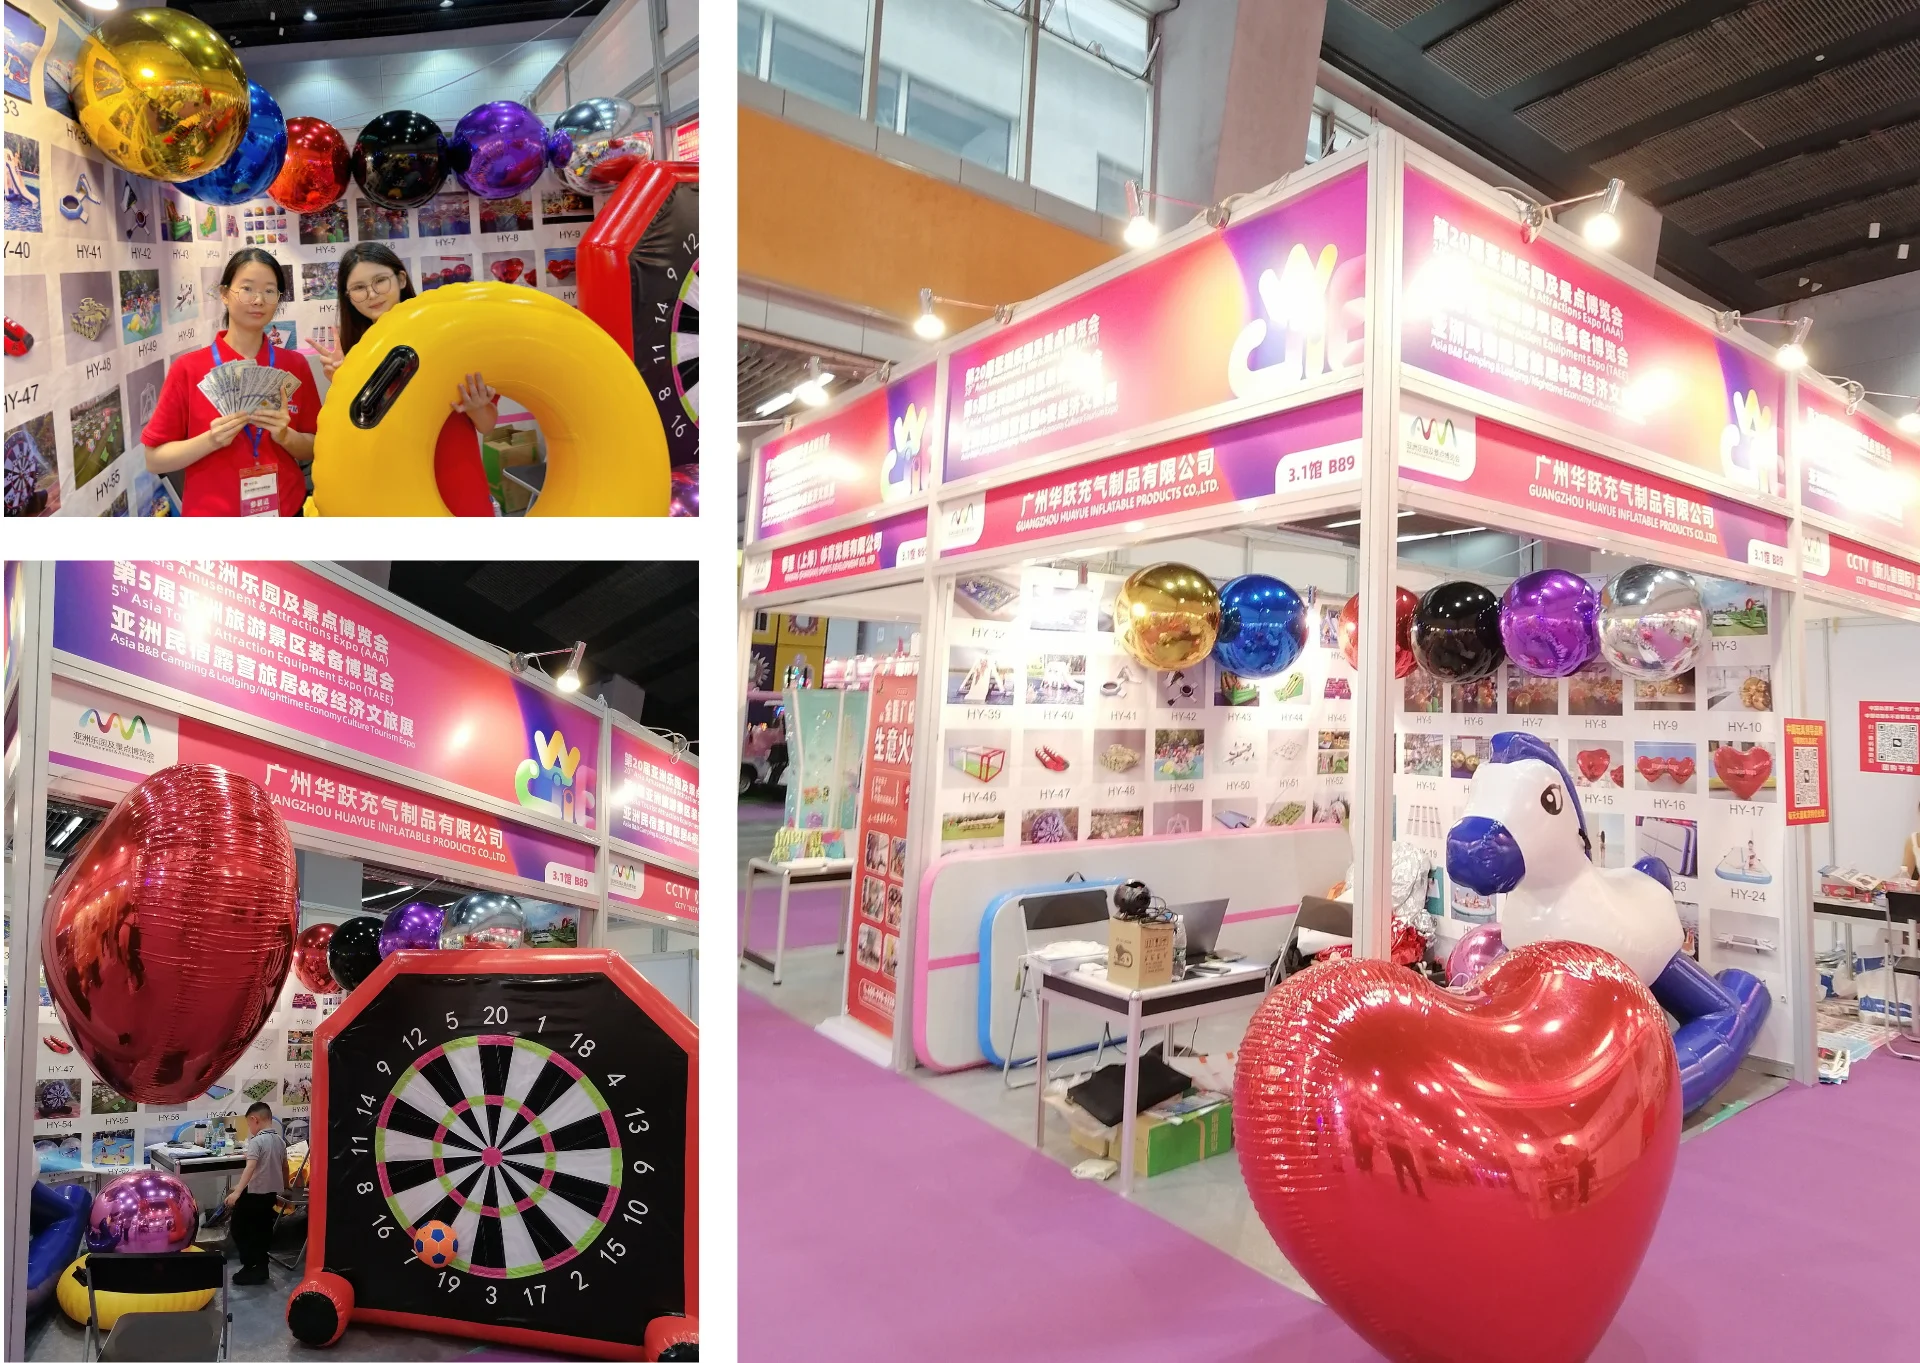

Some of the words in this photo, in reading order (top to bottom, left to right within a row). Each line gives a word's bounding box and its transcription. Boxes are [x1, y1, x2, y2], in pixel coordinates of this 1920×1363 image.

[66, 123, 92, 148] HY-34
[435, 238, 456, 247] HY-7
[497, 234, 519, 242] HY-8
[559, 230, 581, 239] HY-9
[76, 244, 102, 259] HY-41
[131, 248, 152, 259] HY-42
[172, 249, 190, 260] HY-43
[315, 246, 337, 254] HY-5
[667, 267, 678, 281] 9
[655, 302, 669, 323] 14
[1582, 315, 1602, 330] Expo
[1602, 321, 1624, 342] (AAA)
[138, 340, 158, 355] HY-49
[651, 345, 666, 364] 11
[1543, 336, 1586, 363] Equipment
[1586, 352, 1605, 371] Expo
[86, 357, 112, 379] HY-48
[1431, 338, 1448, 350] Asia
[1563, 385, 1592, 407] Economy
[658, 386, 671, 401] 8
[671, 415, 687, 438] 16
[1288, 459, 1322, 482] 3.1馆
[1328, 455, 1355, 475] B89
[96, 468, 121, 501] HY-55
[1020, 447, 1215, 517] 广州华跃充气制品有限公司
[1535, 454, 1714, 529] 广州华跃充气制品有限公司
[1015, 513, 1058, 533] GUANGZHOU
[1060, 505, 1089, 523] HUAYUE
[1090, 496, 1134, 517] INFLATABLE
[1136, 487, 1181, 508] PRODUCTS
[1529, 483, 1584, 509] GUANGZHOU
[1586, 499, 1616, 518] HUAYUE
[1618, 507, 1659, 529] INFLATABLE
[1659, 520, 1693, 538] PRODUCTS
[1772, 554, 1784, 567] B89
[1847, 552, 1869, 573] CCTY
[178, 561, 389, 655] 亚洲乐园及景点博览会
[178, 566, 257, 609] Amusement
[259, 602, 267, 613] &
[269, 607, 331, 641] Attractions
[333, 634, 359, 653] Expo
[360, 645, 389, 667] (AAA)
[131, 593, 162, 615] Asia
[214, 627, 274, 659] Attraction
[277, 652, 336, 684] Equipment
[338, 675, 362, 693] Expo
[364, 686, 394, 707] (TAEE)
[1711, 640, 1737, 651] HY-3
[110, 632, 136, 650] Asia
[137, 642, 159, 658] B&B
[160, 651, 207, 680] Camping
[208, 668, 216, 679] &
[304, 702, 342, 723] Economy
[342, 715, 370, 732] Culture
[370, 725, 399, 743] Tourism
[399, 735, 416, 750] Expo
[966, 709, 1001, 720] HY-39
[1110, 710, 1137, 720] HY-41
[1171, 712, 1197, 721] HY-42
[1227, 712, 1252, 721] HY-43
[1281, 713, 1303, 722] HY-44
[1327, 714, 1347, 722] HY-45
[1464, 717, 1483, 726] HY-6
[1522, 717, 1543, 728] HY-7
[1585, 719, 1607, 729] HY-8
[1653, 720, 1678, 731] HY-9
[1728, 722, 1762, 733] HY-10
[873, 726, 915, 765] 生意火
[1170, 783, 1195, 793] HY-49
[1226, 780, 1250, 790] HY-50
[1416, 781, 1436, 791] HY-12
[962, 791, 997, 803] HY-46
[1040, 788, 1071, 800] HY-47
[1585, 794, 1614, 805] HY-15
[264, 763, 503, 849] 广州华跃充气制品有限公司
[1653, 799, 1686, 810] HY-16
[1730, 804, 1763, 817] HY-17
[270, 792, 331, 818] UANGZHOU
[335, 809, 375, 830] HUAYUE
[378, 821, 430, 844] INFLATABLE
[433, 838, 476, 856] PRODUCTS
[553, 871, 571, 886] 3.1馆
[574, 876, 588, 888] B89
[665, 881, 690, 901] CCTY
[1731, 888, 1766, 902] HY-24
[445, 1011, 459, 1030] 5
[482, 1005, 509, 1025] 20
[538, 1015, 547, 1034] 1
[402, 1027, 428, 1051] 12
[569, 1032, 596, 1058] 18
[48, 1065, 74, 1074] HY-47
[376, 1060, 392, 1076] 9
[606, 1073, 627, 1087] 4
[356, 1093, 377, 1117] 14
[46, 1121, 72, 1129] HY-54
[105, 1117, 129, 1125] HY-55
[624, 1107, 650, 1134] 13
[350, 1136, 369, 1156] 11
[356, 1181, 374, 1195] 8
[623, 1199, 649, 1226] 10
[371, 1214, 395, 1240] 16
[599, 1237, 626, 1265] 15
[436, 1271, 461, 1293] 19
[569, 1270, 590, 1291] 2
[485, 1286, 498, 1305] 3
[523, 1284, 547, 1306] 17
